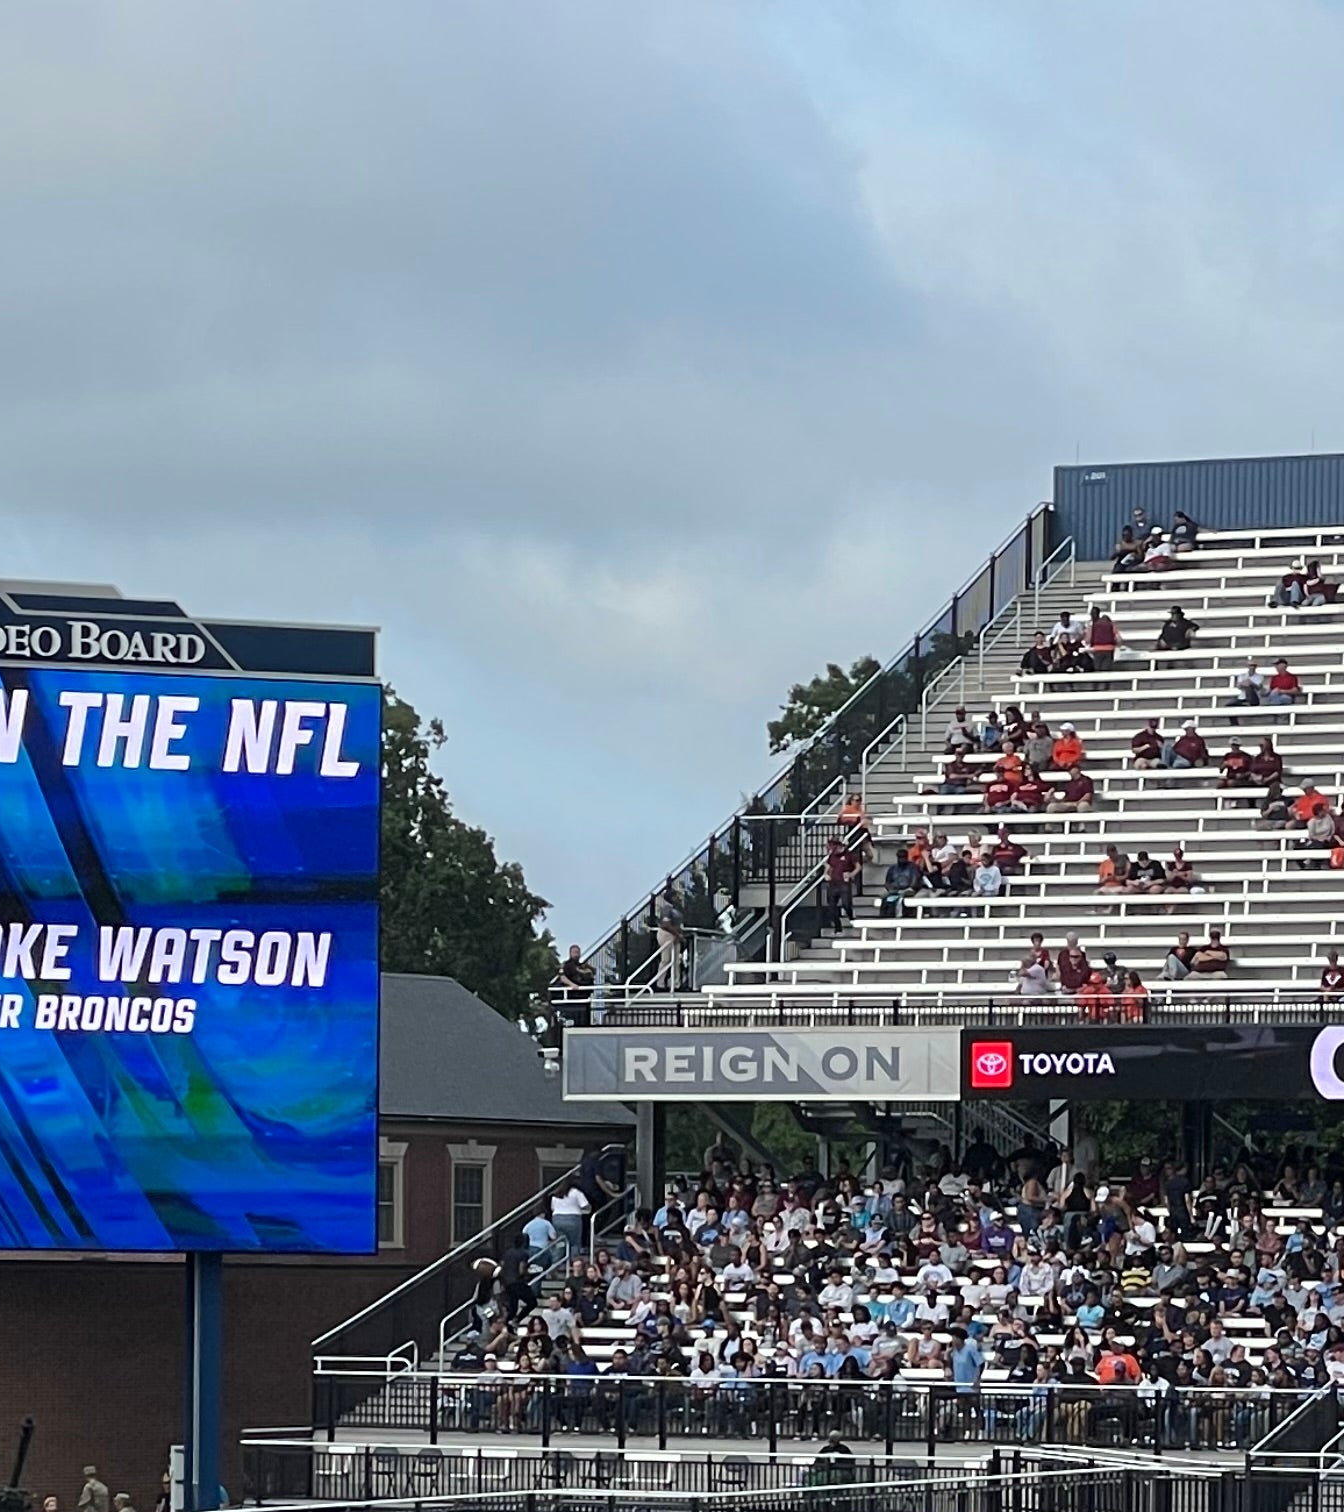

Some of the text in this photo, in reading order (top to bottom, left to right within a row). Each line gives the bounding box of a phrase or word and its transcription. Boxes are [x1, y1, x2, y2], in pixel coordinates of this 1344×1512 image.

[57, 692, 200, 770] THE
[223, 698, 361, 778] NFL
[97, 927, 331, 987] WATSON
[35, 995, 196, 1034] BRONCOS
[622, 1044, 901, 1083] REIGN ON
[1018, 1051, 1115, 1076] TOYOTA
